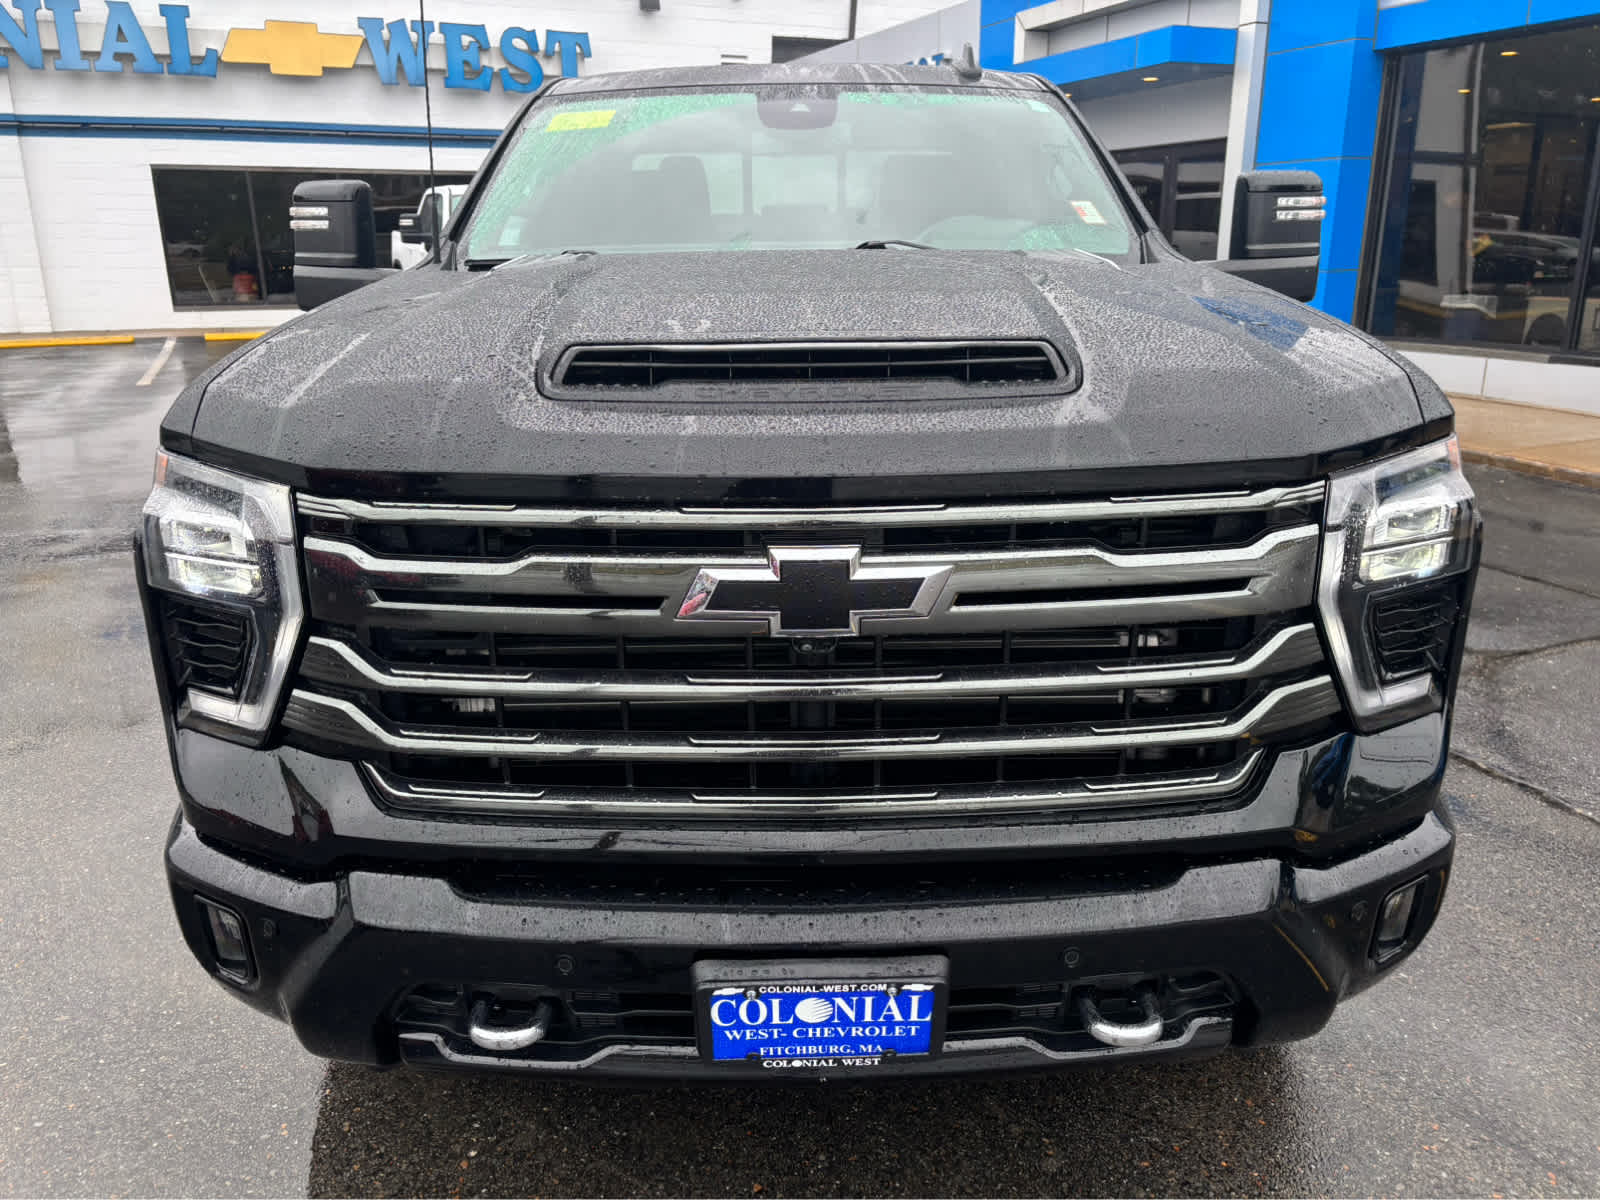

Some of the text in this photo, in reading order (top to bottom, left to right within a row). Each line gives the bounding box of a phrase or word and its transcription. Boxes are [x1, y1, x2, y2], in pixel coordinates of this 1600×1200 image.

[357, 16, 592, 92] WEST
[759, 984, 887, 994] COLONIAL-WEST.COM
[793, 1026, 920, 1038] CHEVROLET
[859, 1044, 884, 1054] MA
[845, 1057, 882, 1067] WEST
